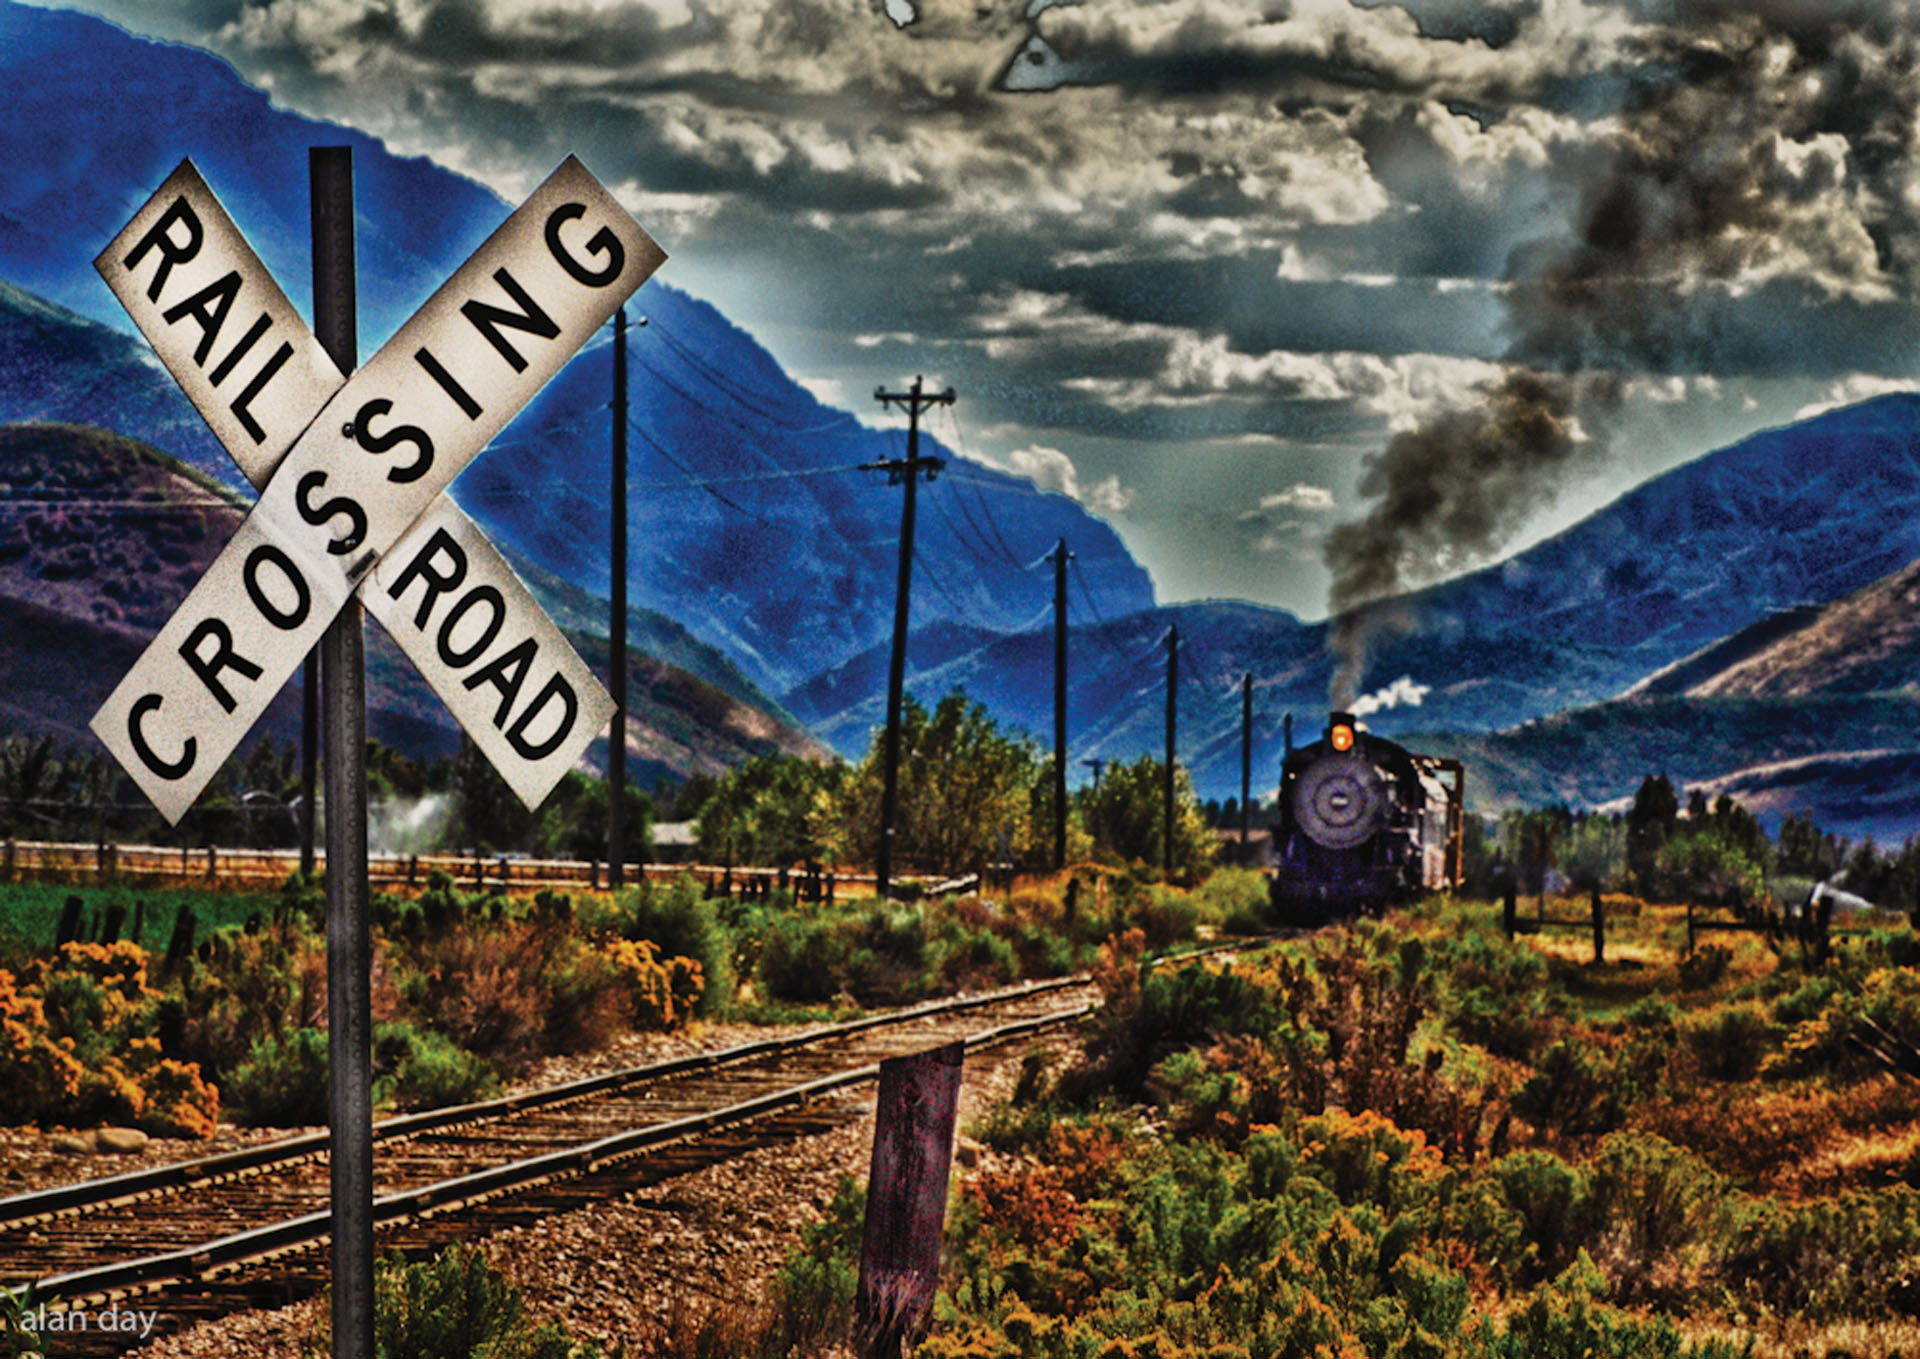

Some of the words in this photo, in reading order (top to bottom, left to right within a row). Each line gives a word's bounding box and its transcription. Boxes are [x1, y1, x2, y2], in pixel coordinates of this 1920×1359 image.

[122, 194, 295, 446] RAIL
[387, 527, 579, 761] ROAD
[127, 202, 625, 781] CROSSING
